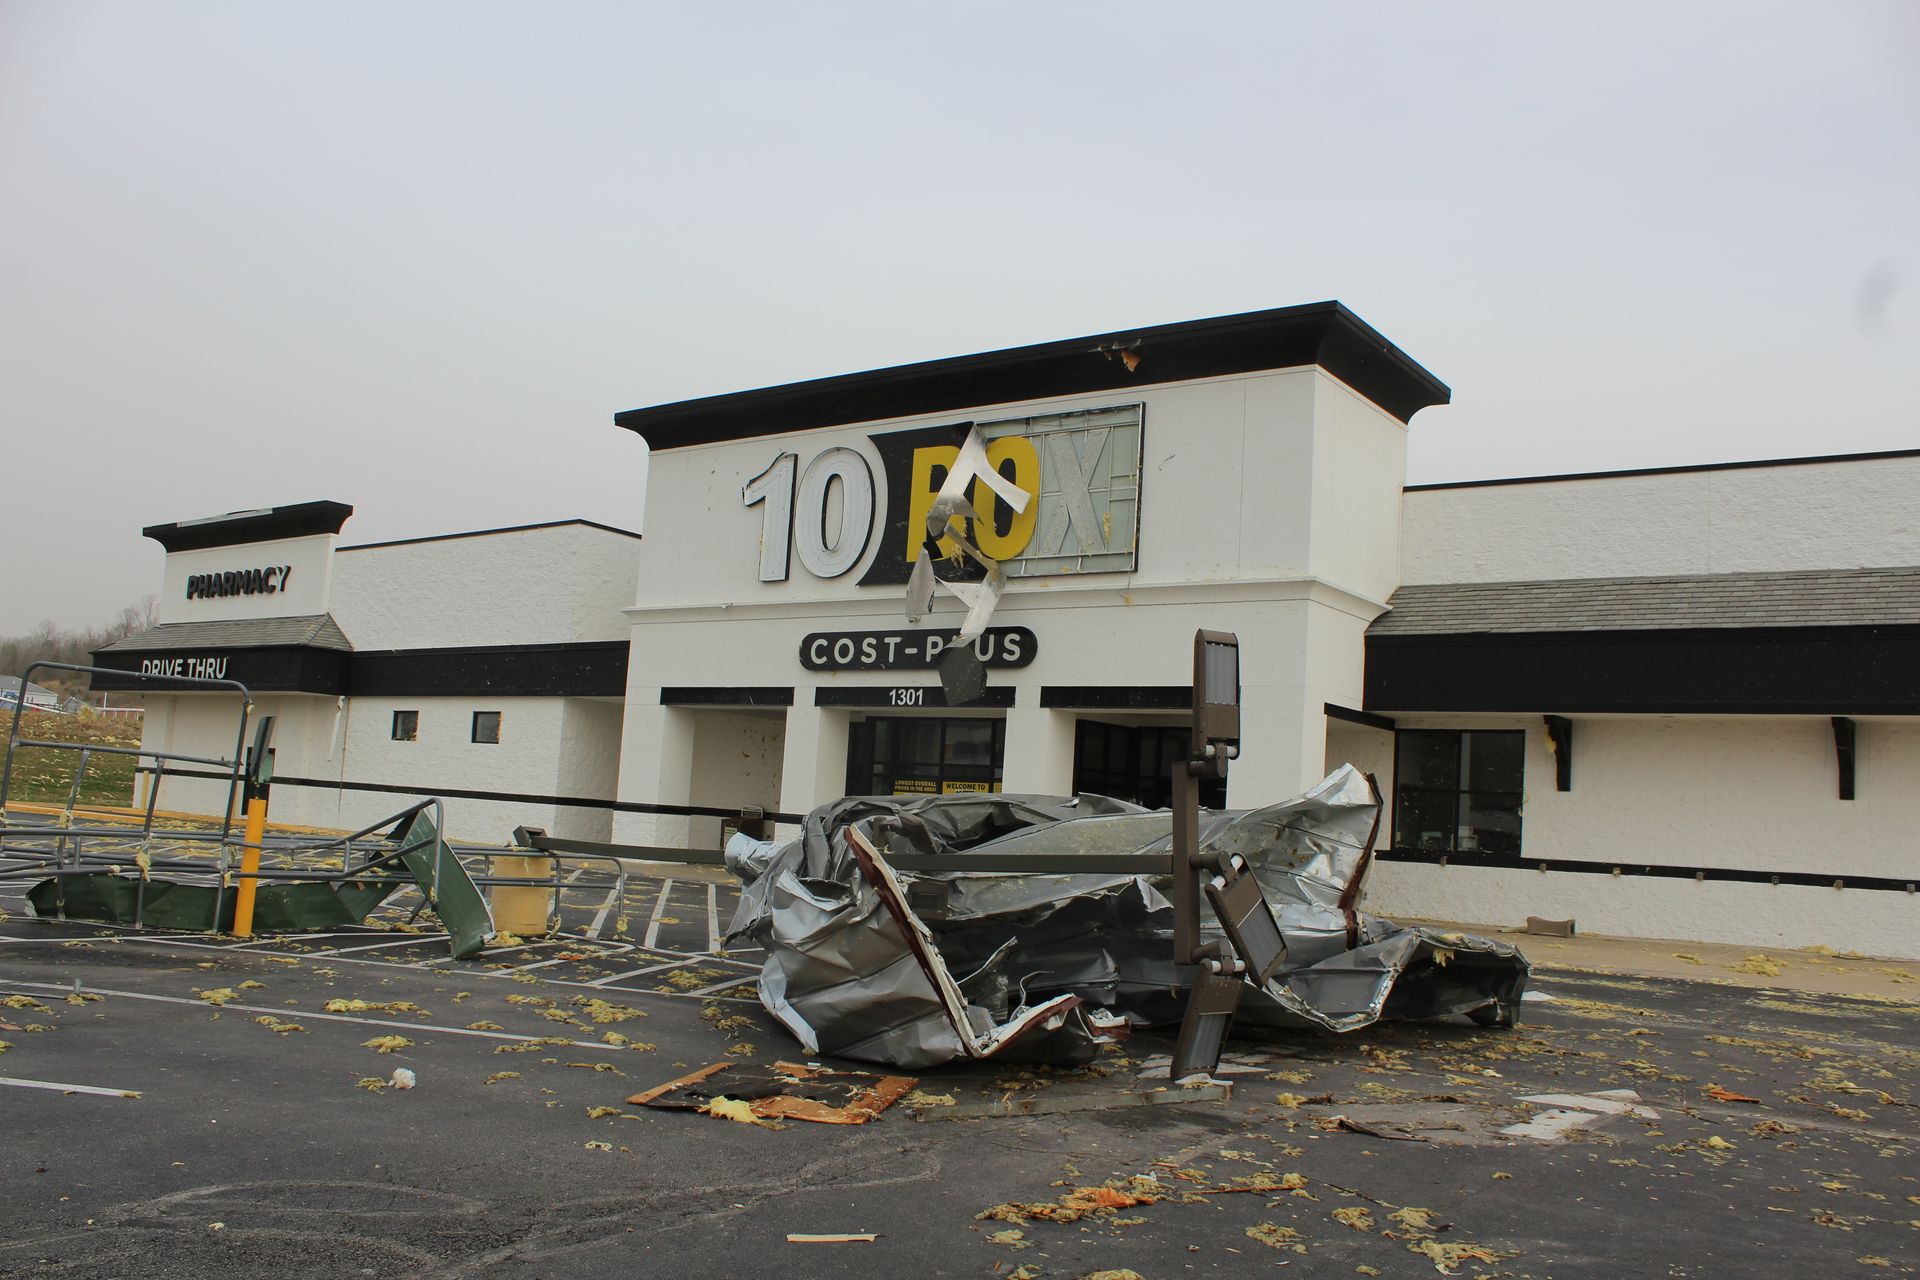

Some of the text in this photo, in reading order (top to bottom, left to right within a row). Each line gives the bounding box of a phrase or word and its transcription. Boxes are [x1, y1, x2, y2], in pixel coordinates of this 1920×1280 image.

[742, 446, 876, 582] 10
[187, 565, 291, 600] PHARMACY
[810, 633, 1022, 664] COST-PUS
[142, 657, 228, 680] DRIVE THRU
[889, 688, 924, 706] 1301
